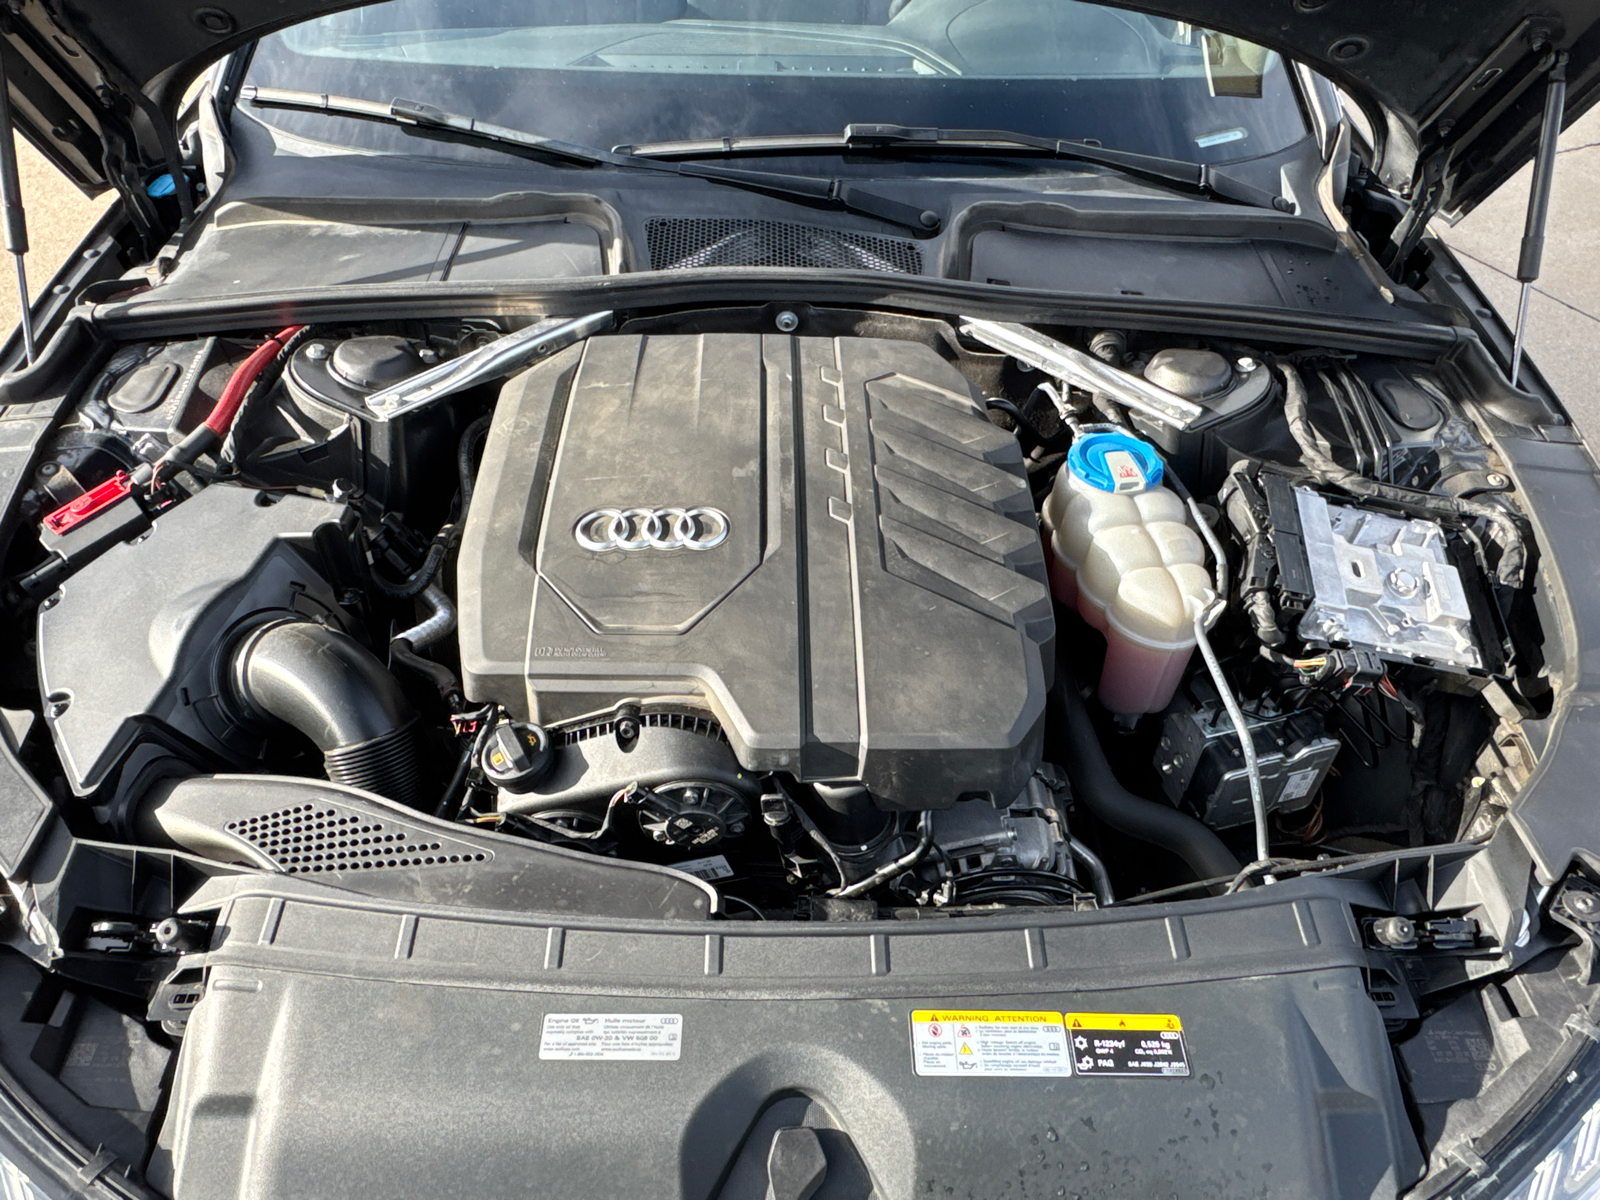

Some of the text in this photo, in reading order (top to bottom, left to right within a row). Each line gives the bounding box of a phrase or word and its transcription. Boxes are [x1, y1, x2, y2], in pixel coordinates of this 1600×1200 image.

[942, 1014, 1047, 1023] WARNING ATTENTION
[1093, 1039, 1126, 1049] R-1234yf
[1161, 1041, 1171, 1049] kg
[1097, 1059, 1114, 1067] PAG
